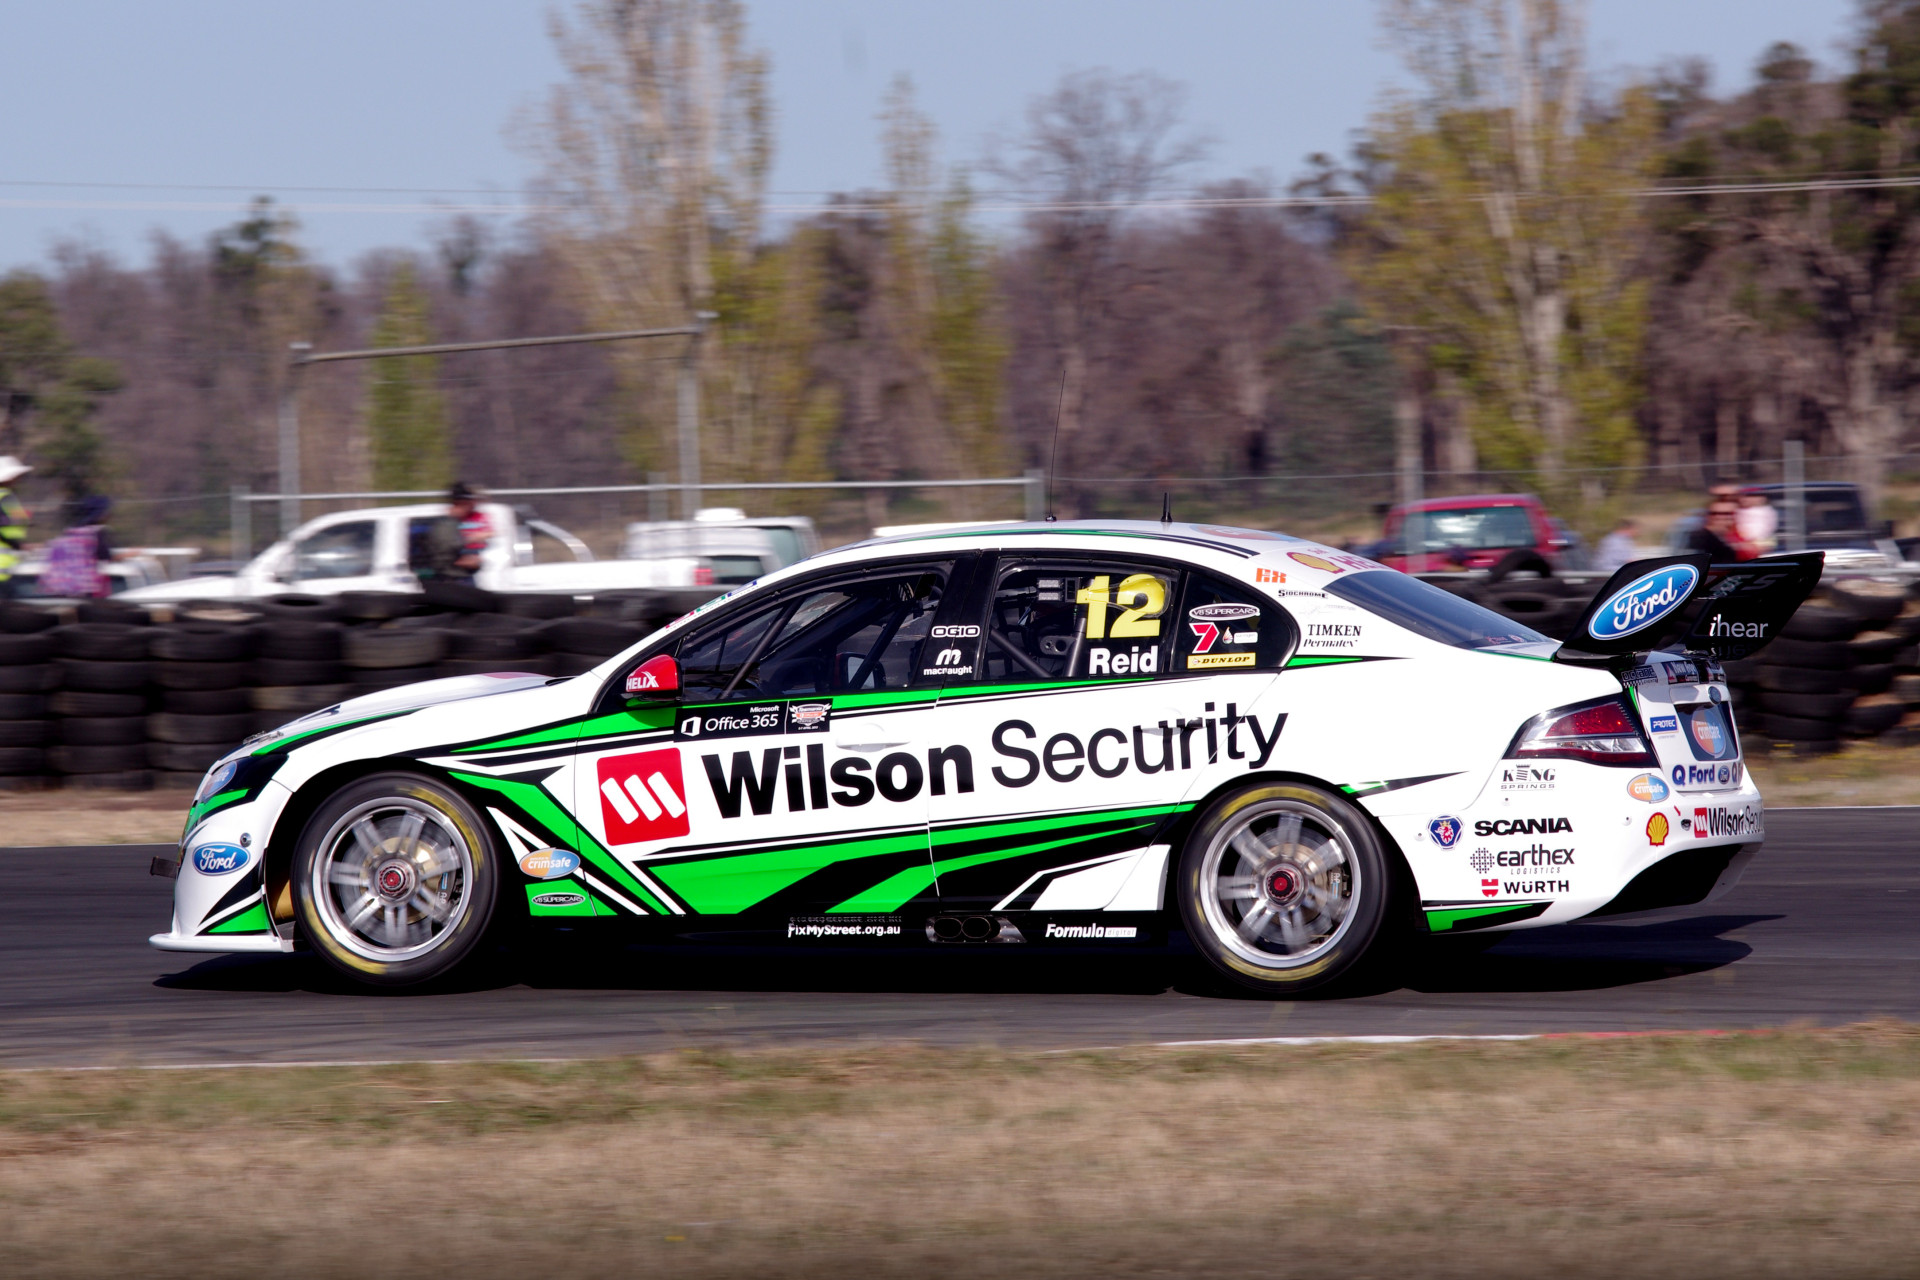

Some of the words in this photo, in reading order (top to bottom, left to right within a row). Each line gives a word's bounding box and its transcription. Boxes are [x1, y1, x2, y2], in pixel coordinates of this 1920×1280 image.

[1076, 573, 1161, 639] 12
[1205, 607, 1256, 616] SUPERCARS
[1613, 576, 1678, 631] Ford
[931, 625, 981, 638] OGIO
[1308, 624, 1362, 637] TIMKEN
[1709, 614, 1768, 638] ihear
[1089, 645, 1159, 675] Reid
[1201, 656, 1251, 665] DUNLOP
[923, 665, 973, 676] macnaught
[626, 671, 659, 689] HELIX
[750, 705, 780, 713] Microsoft
[705, 716, 750, 732] Office
[750, 713, 779, 729] 365
[1652, 719, 1676, 729] PROTEC
[701, 743, 975, 819] Wilson
[991, 702, 1289, 788] Security
[1672, 764, 1686, 787] Q
[1688, 763, 1715, 784] Ford
[1474, 817, 1574, 837] SCANIA
[1708, 807, 1745, 837] Wilson
[199, 847, 237, 870] Ford
[527, 856, 571, 870] crimsafe
[1496, 843, 1576, 867] earthex
[1510, 866, 1561, 876] LOGISTICS
[1045, 922, 1105, 938] Formula
